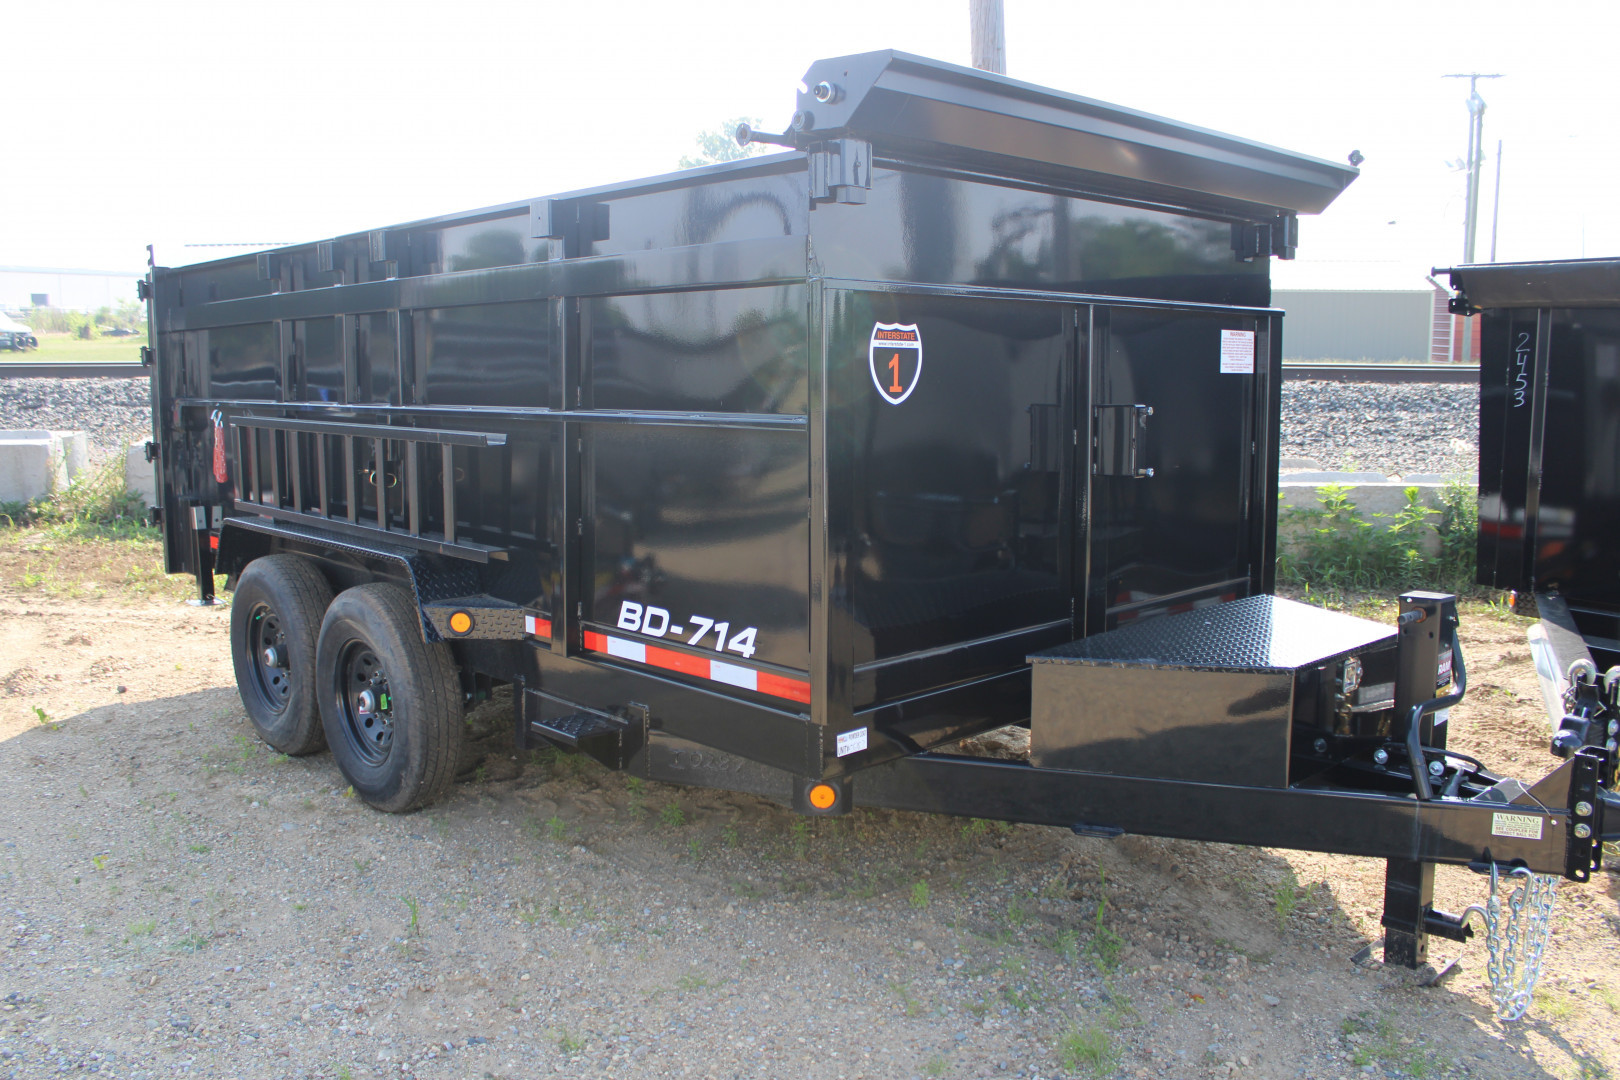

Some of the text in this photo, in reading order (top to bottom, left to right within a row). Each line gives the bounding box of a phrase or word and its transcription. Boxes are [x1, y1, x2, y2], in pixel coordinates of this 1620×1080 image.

[877, 331, 916, 341] INTERSTATE
[888, 353, 903, 393] 1
[1513, 332, 1531, 408] 2453
[617, 600, 758, 659] BD-714
[1496, 814, 1540, 824] WARNING
